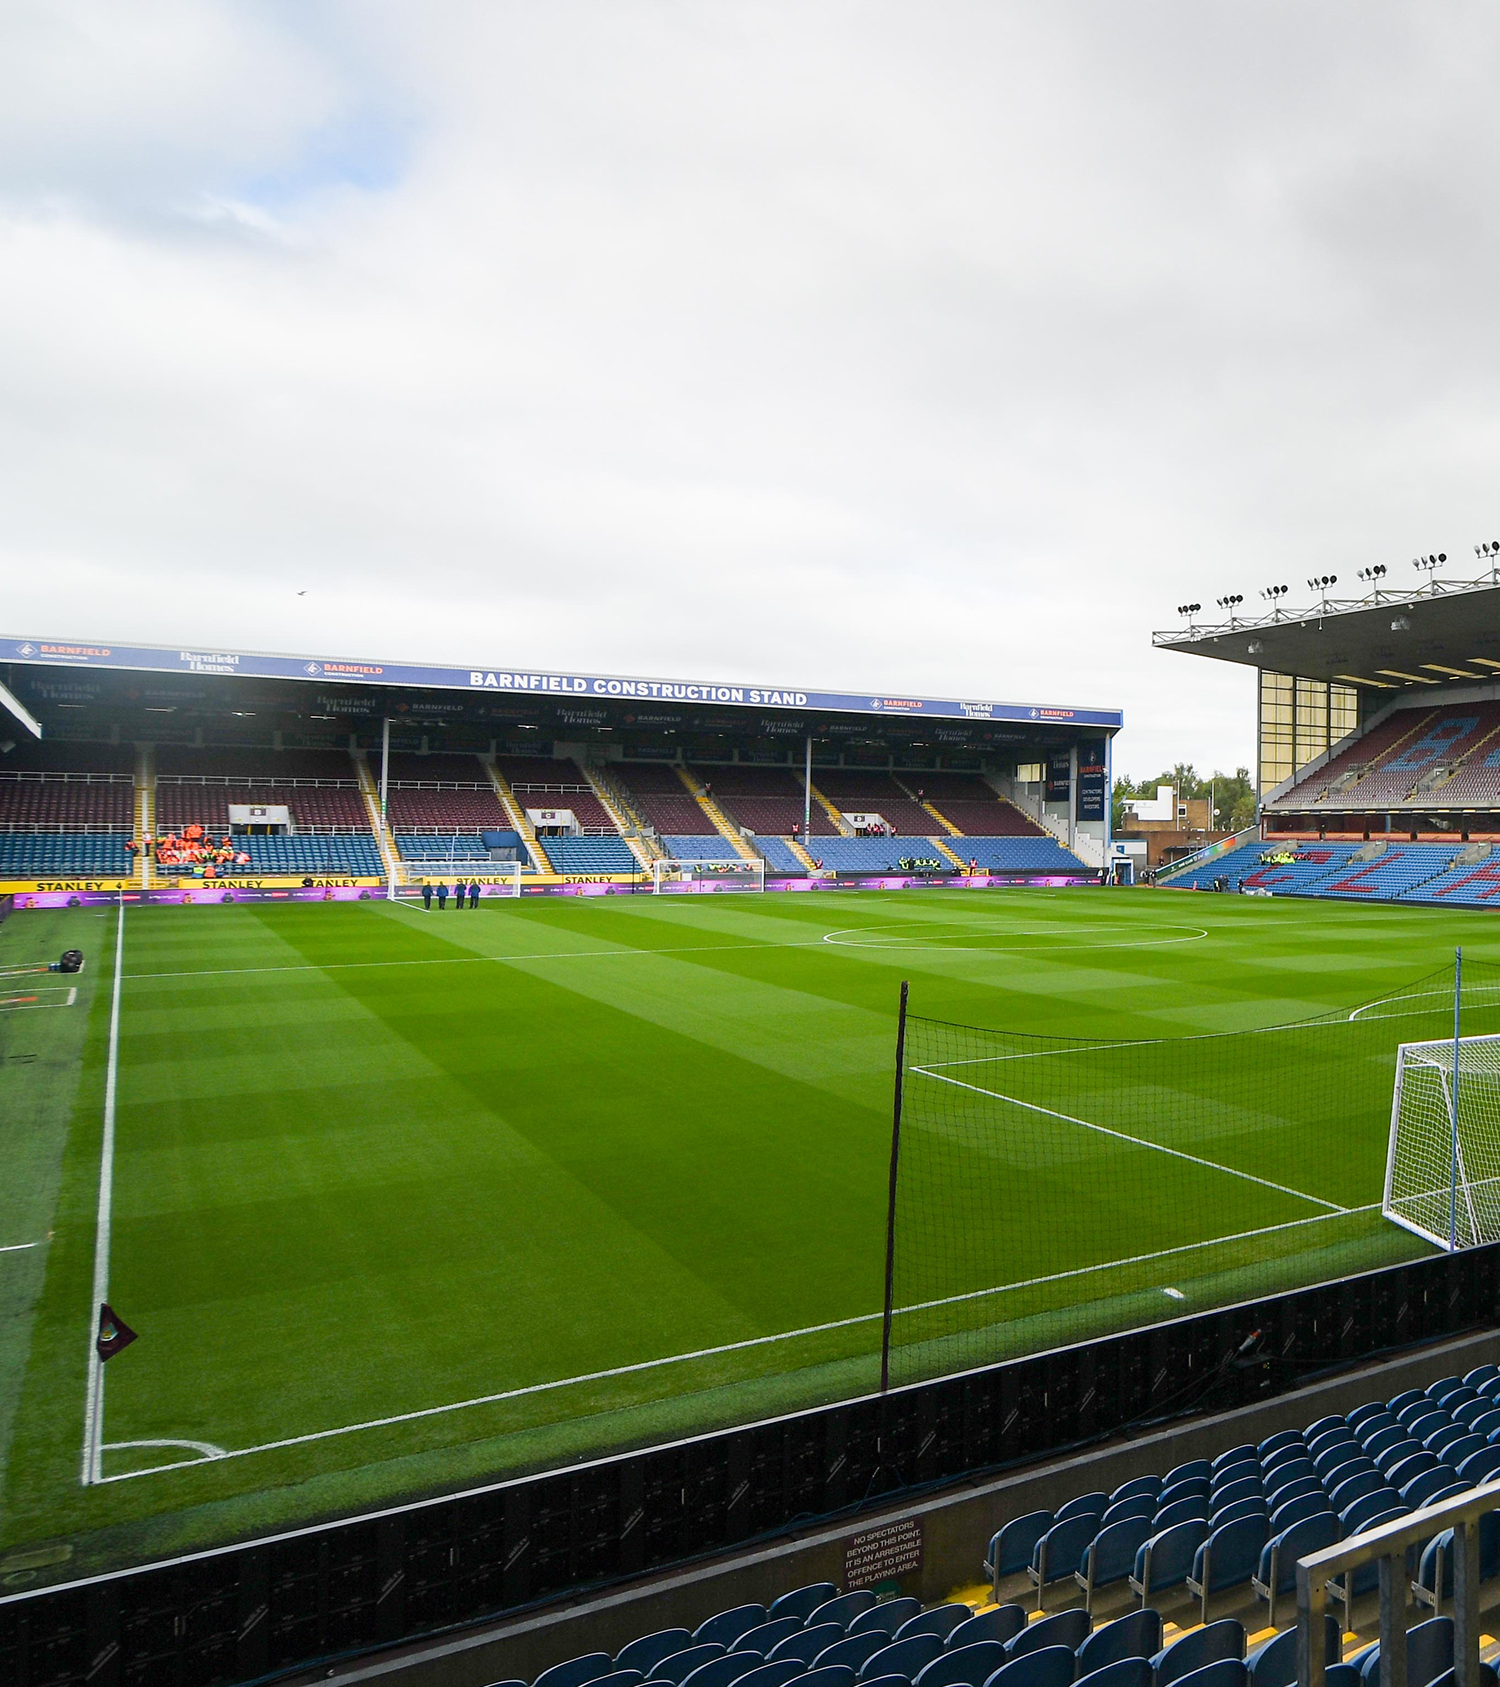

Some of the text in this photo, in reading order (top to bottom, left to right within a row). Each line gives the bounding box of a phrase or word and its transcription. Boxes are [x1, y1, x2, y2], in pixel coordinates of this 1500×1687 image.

[40, 645, 111, 657] BARNFIELD
[181, 651, 239, 665] Barnfield
[190, 661, 235, 673] Homes
[323, 663, 383, 674] BARNFIELD
[470, 672, 807, 706] BARNFIELD CONSTRUCTION STAND
[883, 700, 922, 708] BARNFIELD
[960, 702, 993, 712] Barnfield
[966, 708, 991, 718] Homes
[1040, 710, 1074, 718] BARNFIELD
[37, 882, 104, 891] STANLEY
[203, 880, 263, 888] STANLEY
[853, 1521, 915, 1546] NO SPECTATORS
[846, 1529, 921, 1558] BEYOND THIS POINT.
[845, 1539, 921, 1568] IT IS AN ARRESTABLE
[847, 1549, 920, 1578] OFFENCE TO ENTER
[848, 1561, 918, 1588] THE PLAYING AREA.
